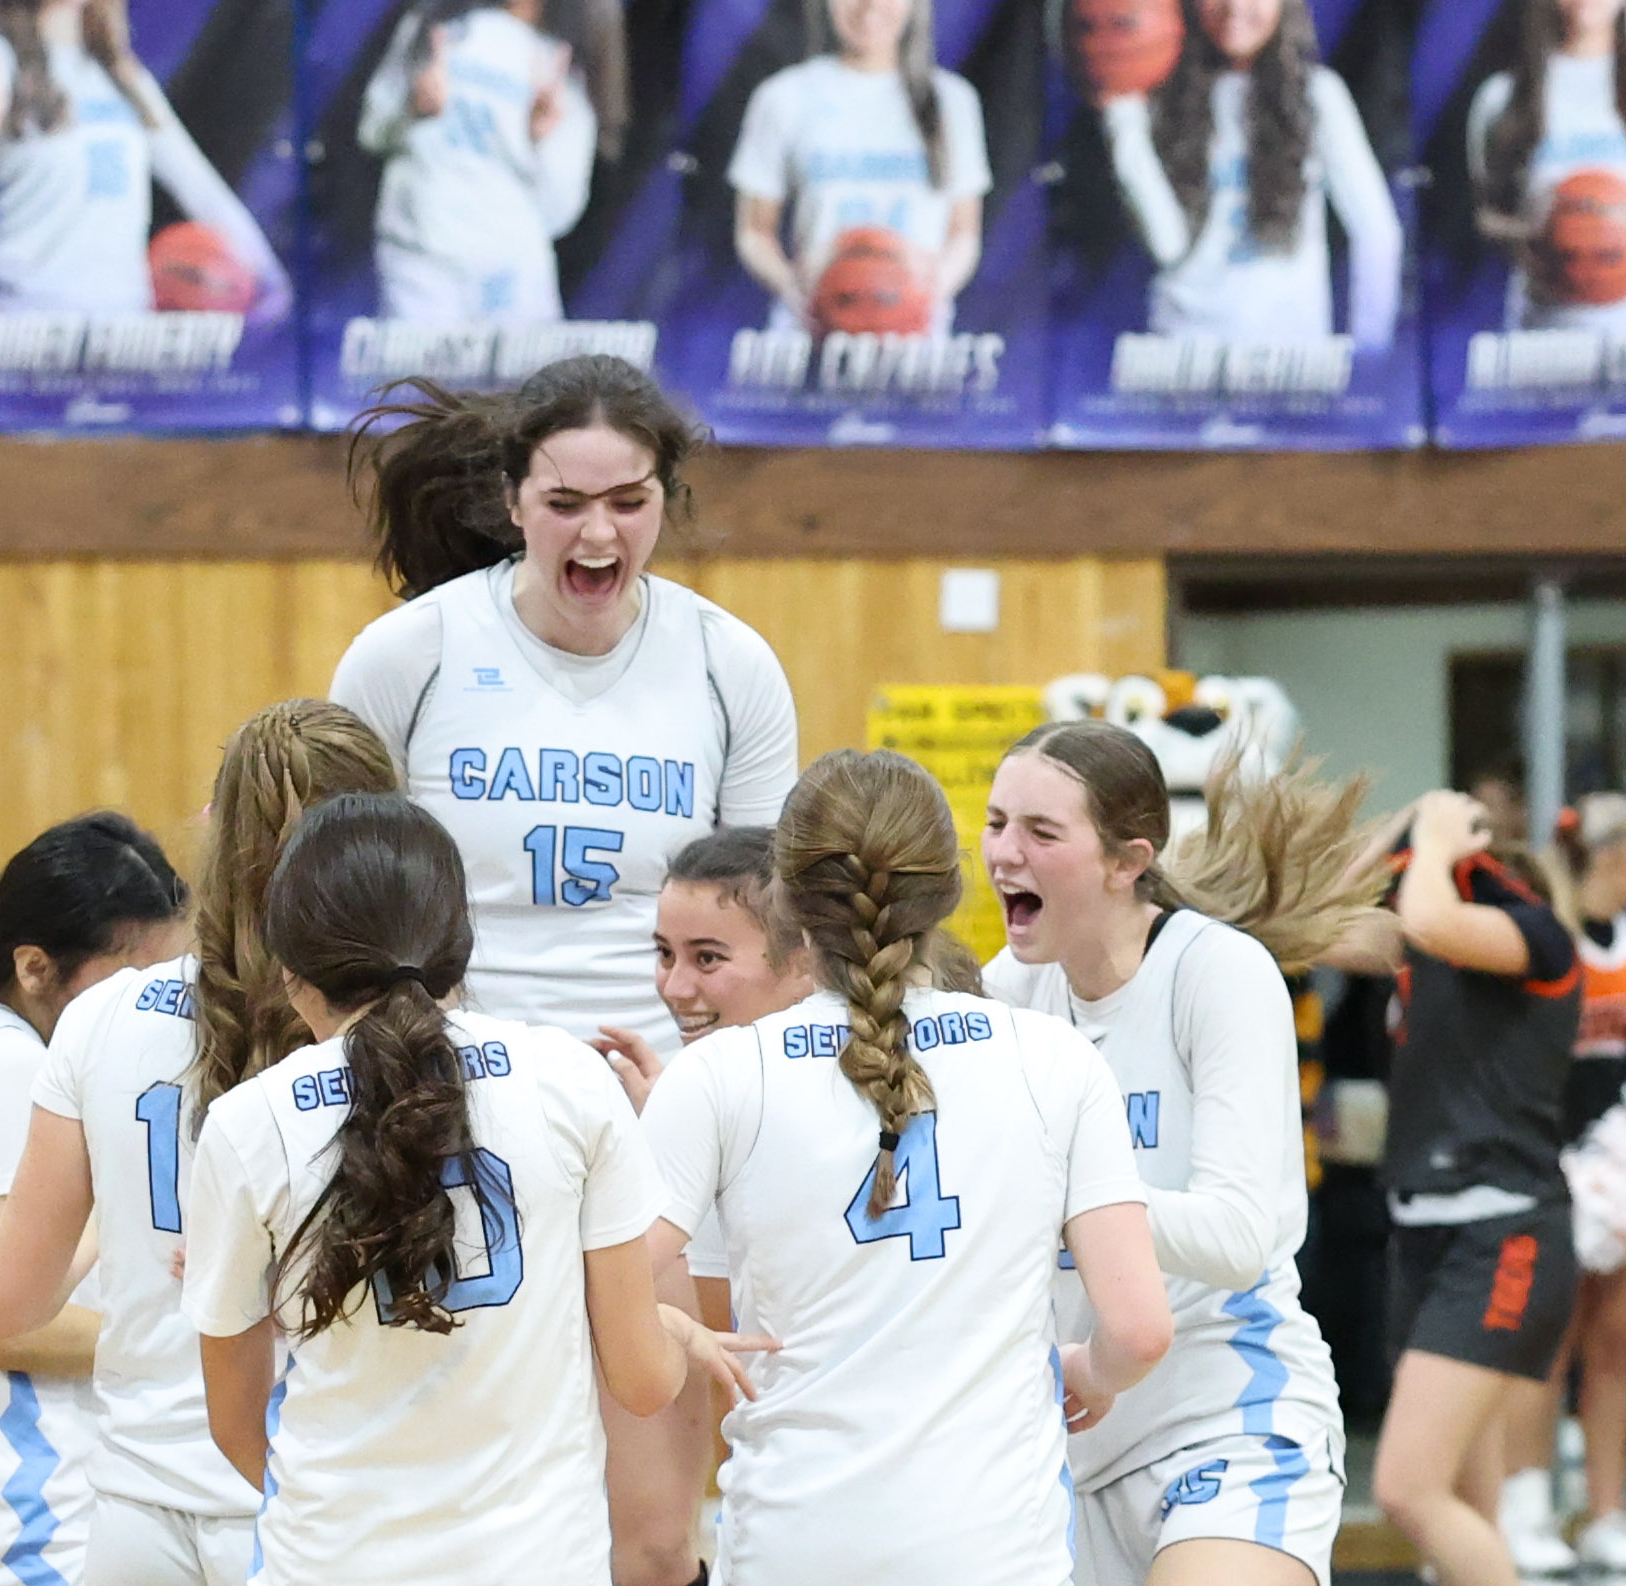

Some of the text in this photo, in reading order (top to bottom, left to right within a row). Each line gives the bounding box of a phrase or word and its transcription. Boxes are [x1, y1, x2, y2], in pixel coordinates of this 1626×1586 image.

[449, 747, 695, 818] CARSON
[523, 824, 624, 906] 15
[844, 1109, 961, 1262] 4
